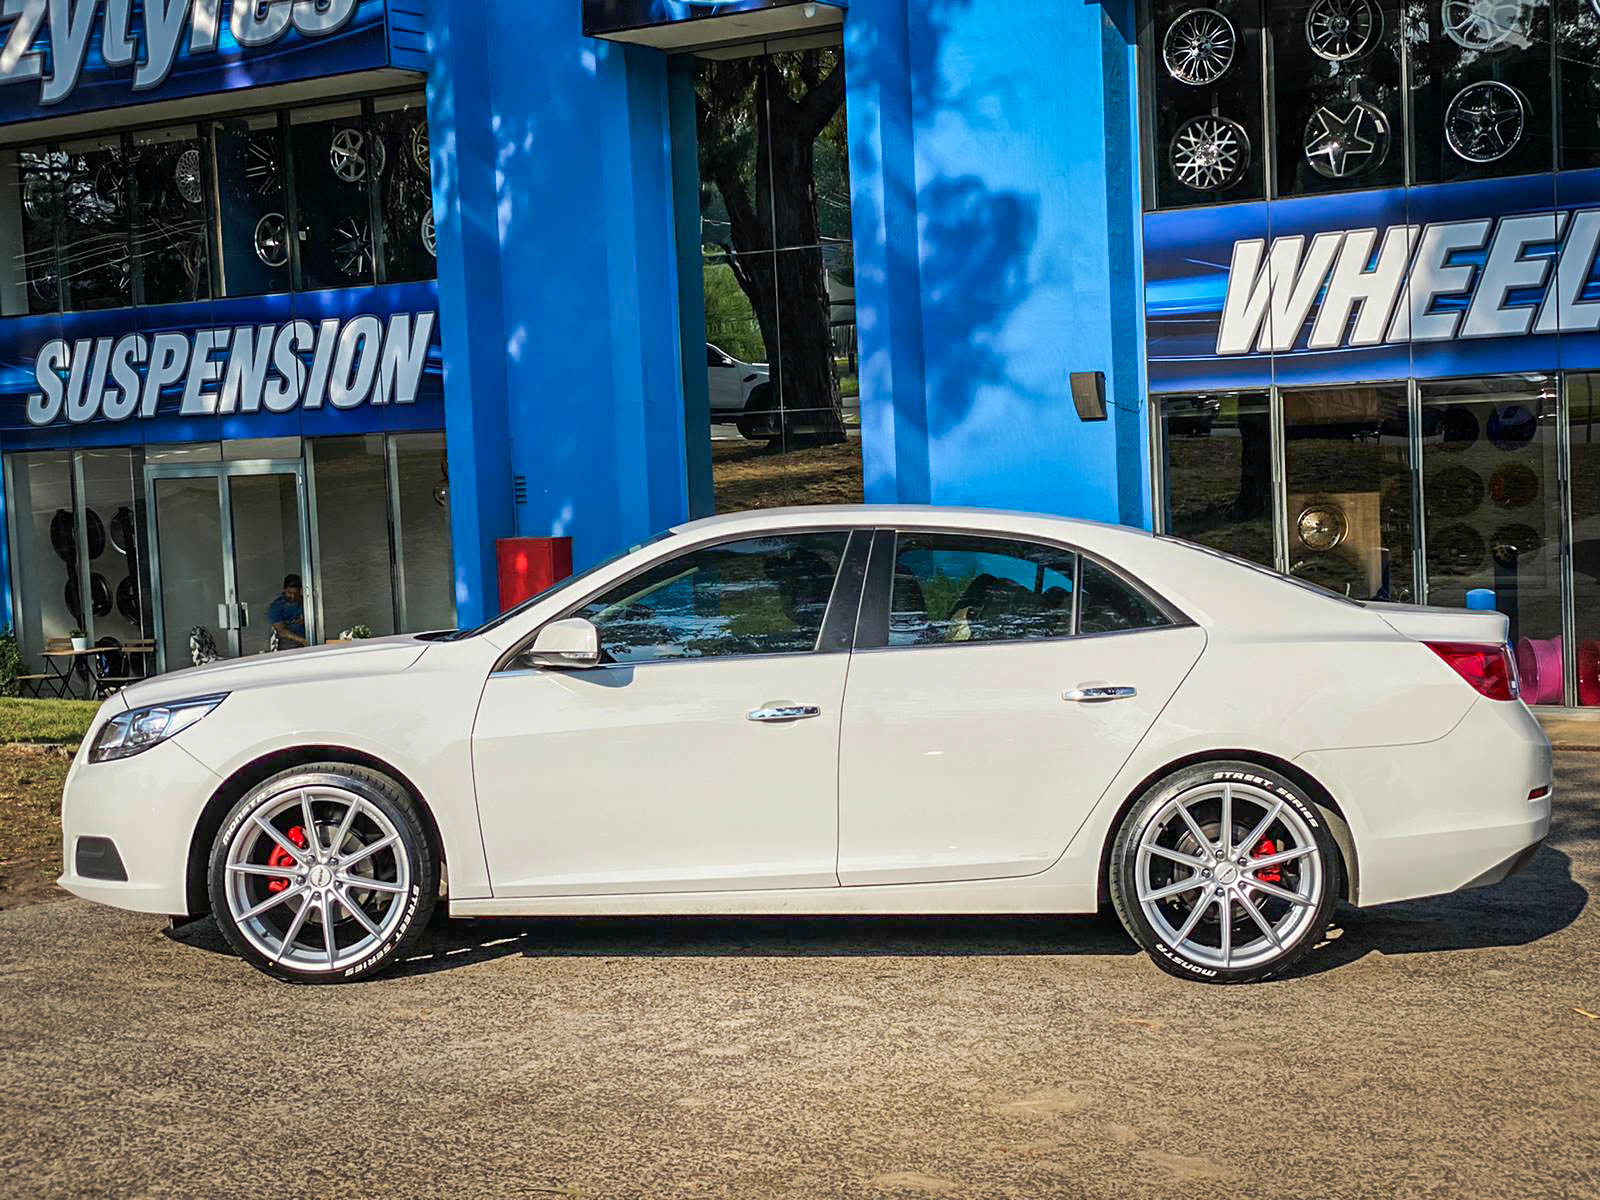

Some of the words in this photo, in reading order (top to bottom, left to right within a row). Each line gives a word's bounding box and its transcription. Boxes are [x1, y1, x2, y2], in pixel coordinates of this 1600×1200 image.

[1216, 209, 1600, 355] WHEEL
[27, 311, 436, 426] SUSPENSION
[1212, 771, 1274, 788] STREET
[1276, 787, 1319, 828] SERIES
[394, 884, 420, 942] STREET
[344, 942, 392, 977] SERIES
